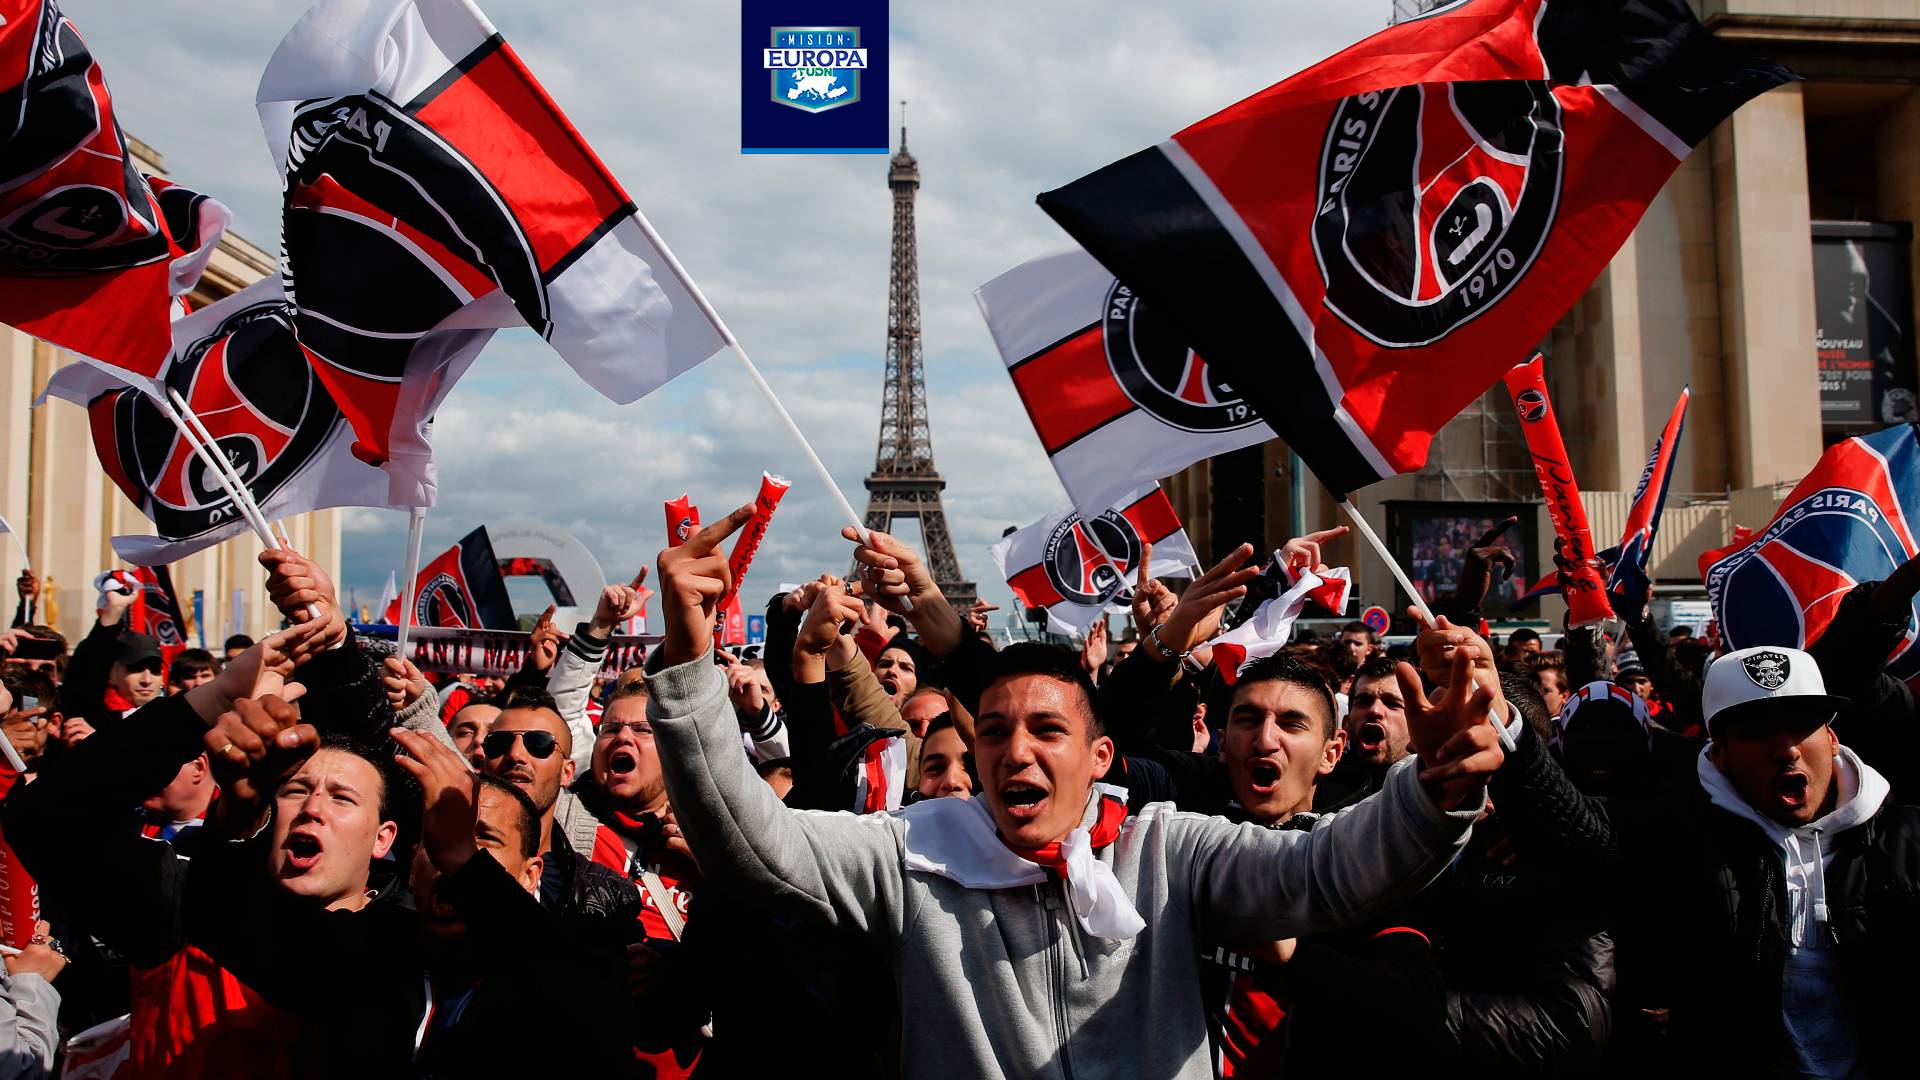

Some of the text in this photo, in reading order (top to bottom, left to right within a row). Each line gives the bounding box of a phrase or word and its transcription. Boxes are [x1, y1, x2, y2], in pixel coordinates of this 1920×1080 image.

[1320, 117, 1368, 217] PARIS
[1459, 248, 1516, 308] 1970
[1110, 285, 1133, 320] PAR
[415, 637, 472, 669] ANTI
[1747, 653, 1784, 662] PIRATES
